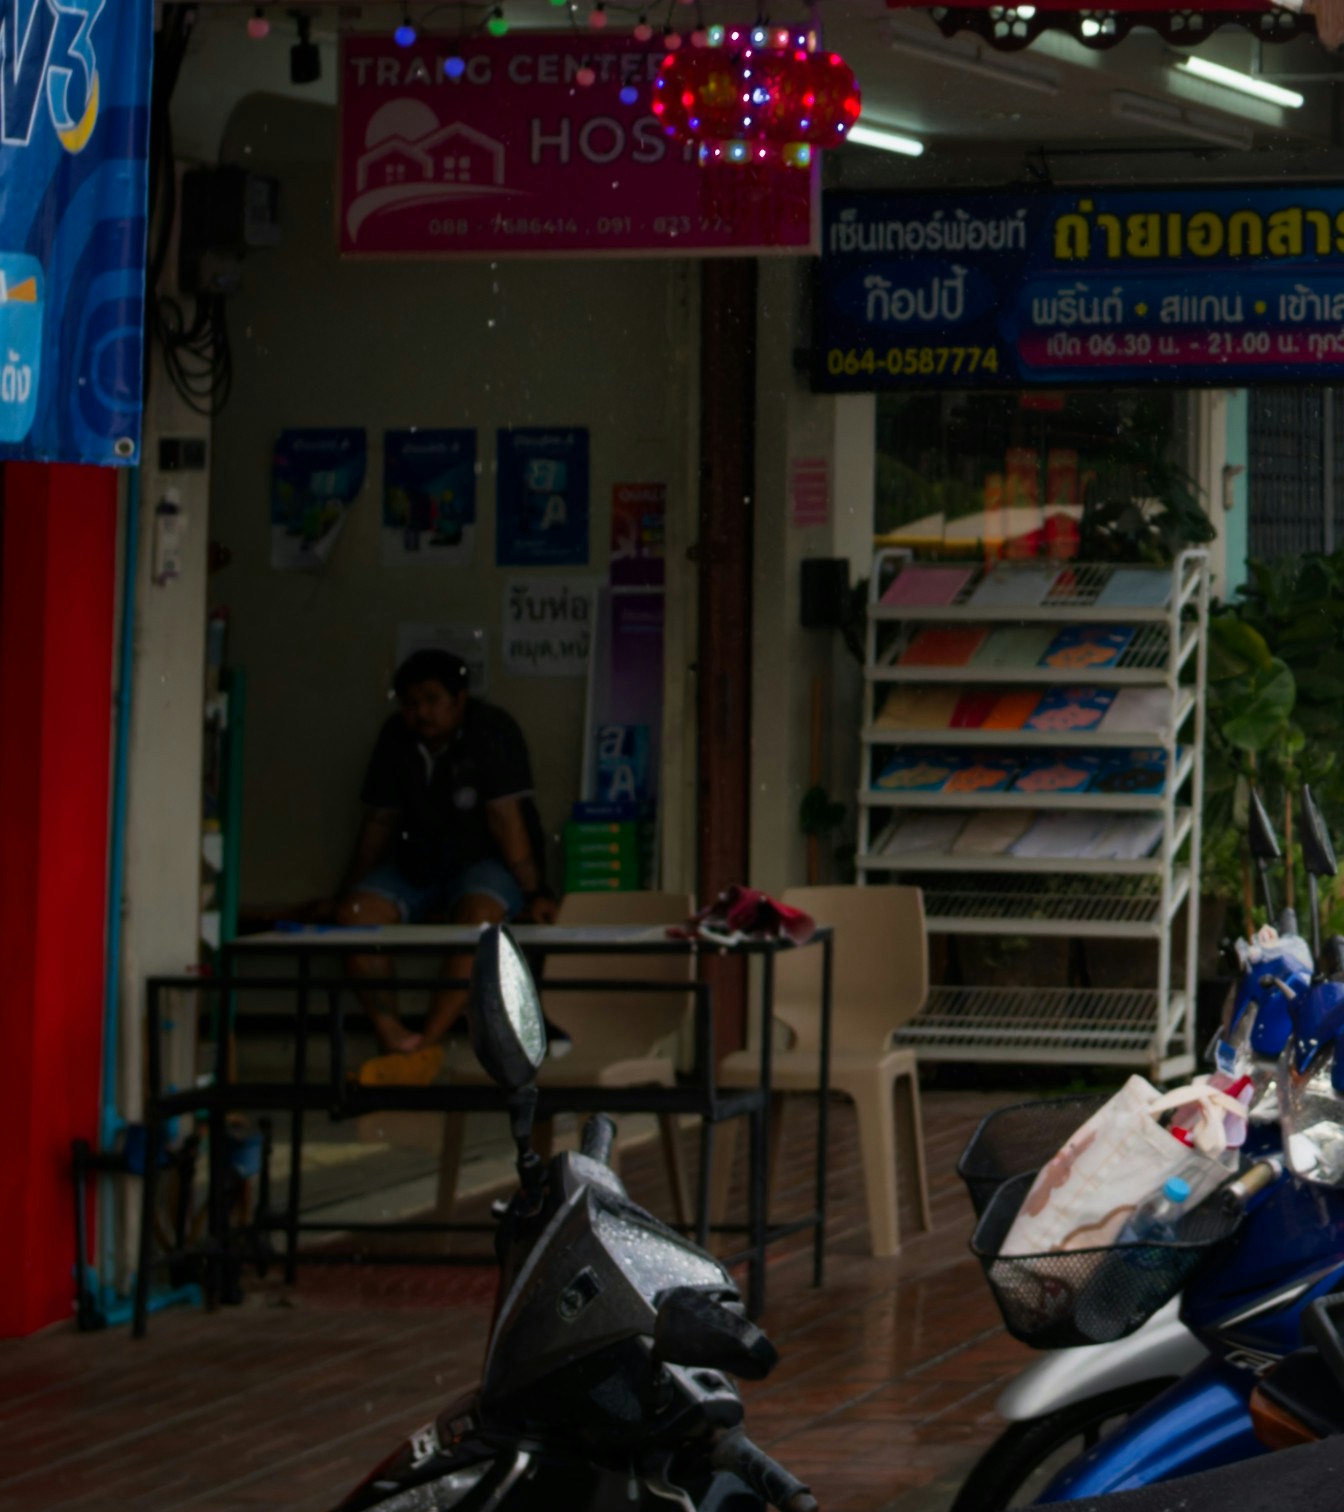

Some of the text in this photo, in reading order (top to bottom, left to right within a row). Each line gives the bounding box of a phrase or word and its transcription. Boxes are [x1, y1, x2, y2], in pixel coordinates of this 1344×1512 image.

[350, 53, 492, 88] TRANG
[530, 116, 694, 166] HOS
[829, 208, 1027, 254] เซ็นเตอร์พ้อยท์
[1031, 284, 1123, 328] พริ้นต์
[1159, 291, 1245, 325] สแกน
[827, 346, 1000, 376] 064-0587774
[1046, 331, 1081, 357] เปิด
[1087, 333, 1152, 357] 06.30
[1208, 330, 1271, 355] 21.00
